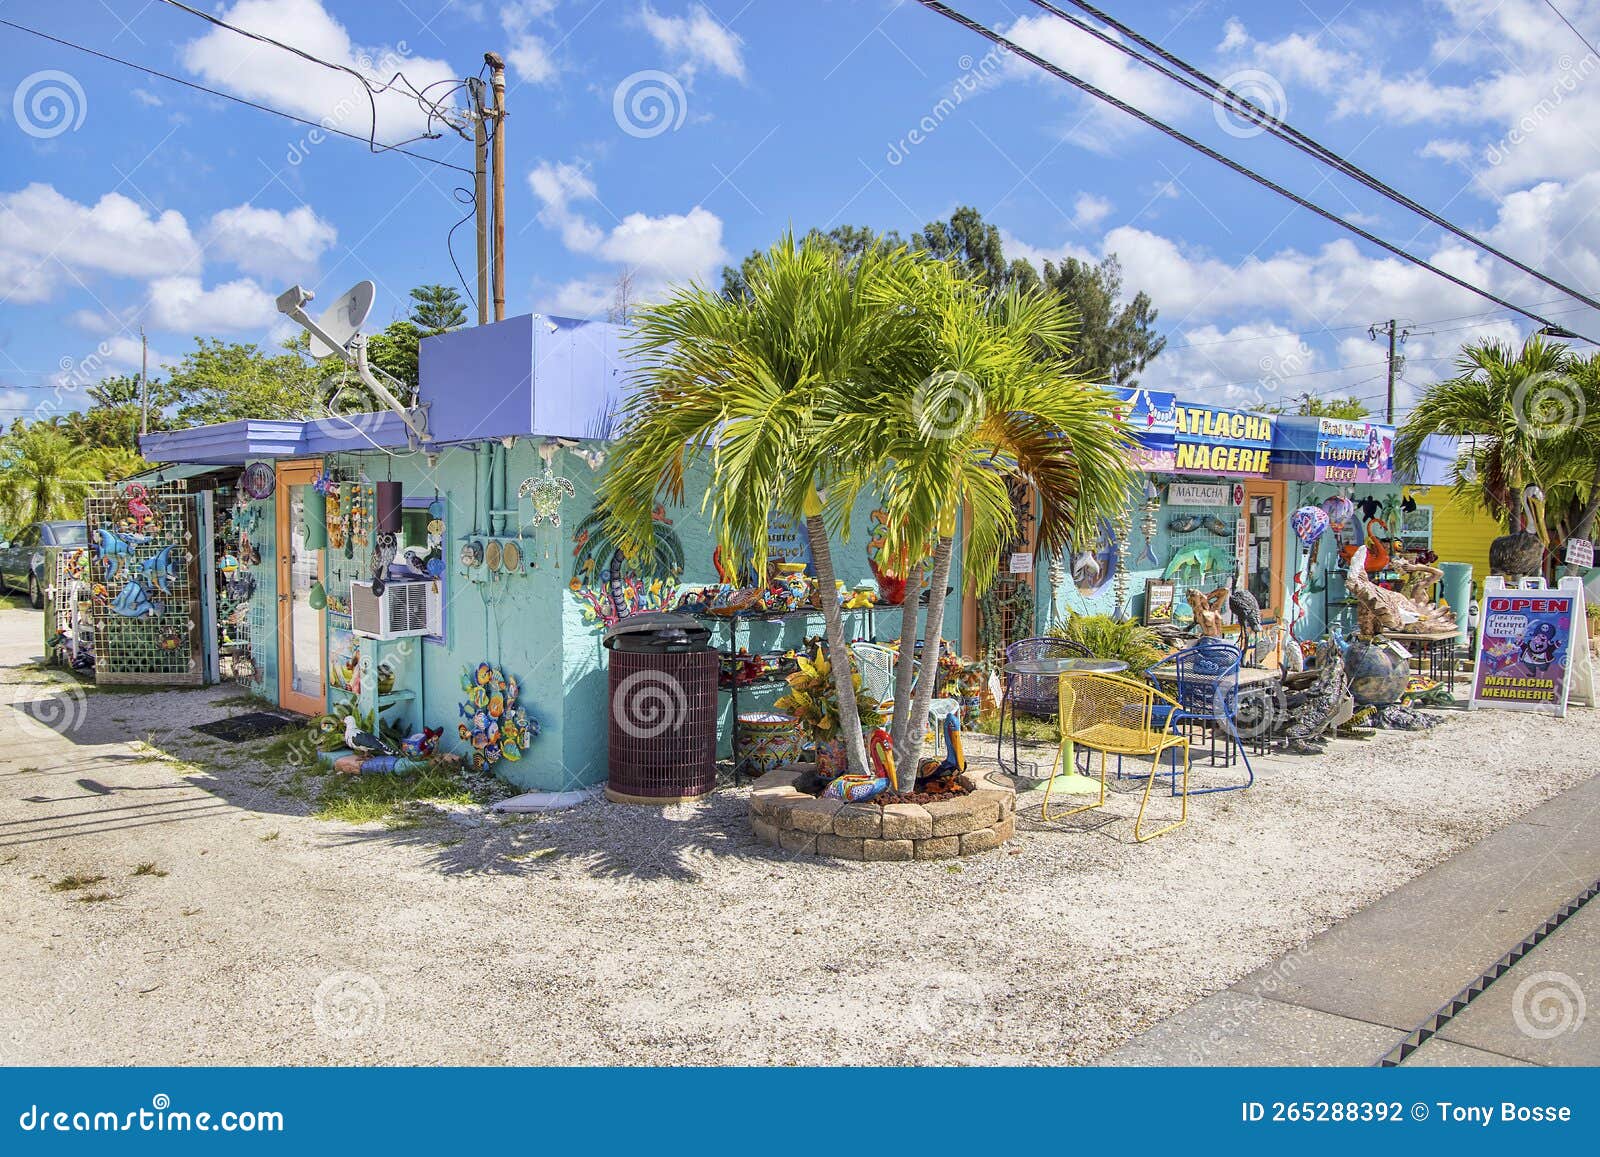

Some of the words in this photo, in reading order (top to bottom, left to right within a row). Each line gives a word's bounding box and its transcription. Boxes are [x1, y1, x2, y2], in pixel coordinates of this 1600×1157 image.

[1174, 406, 1271, 442] ATLACHA
[1321, 420, 1343, 436] Find
[1345, 423, 1366, 439] Your
[1173, 442, 1271, 474] NAGERIE
[1319, 440, 1367, 463] Treasures
[1324, 463, 1358, 481] Here!
[1175, 486, 1223, 498] MATLACHA
[1490, 599, 1569, 613] OPEN
[1485, 676, 1554, 689] MATLACHA
[1481, 687, 1554, 701] MENAGERIE
